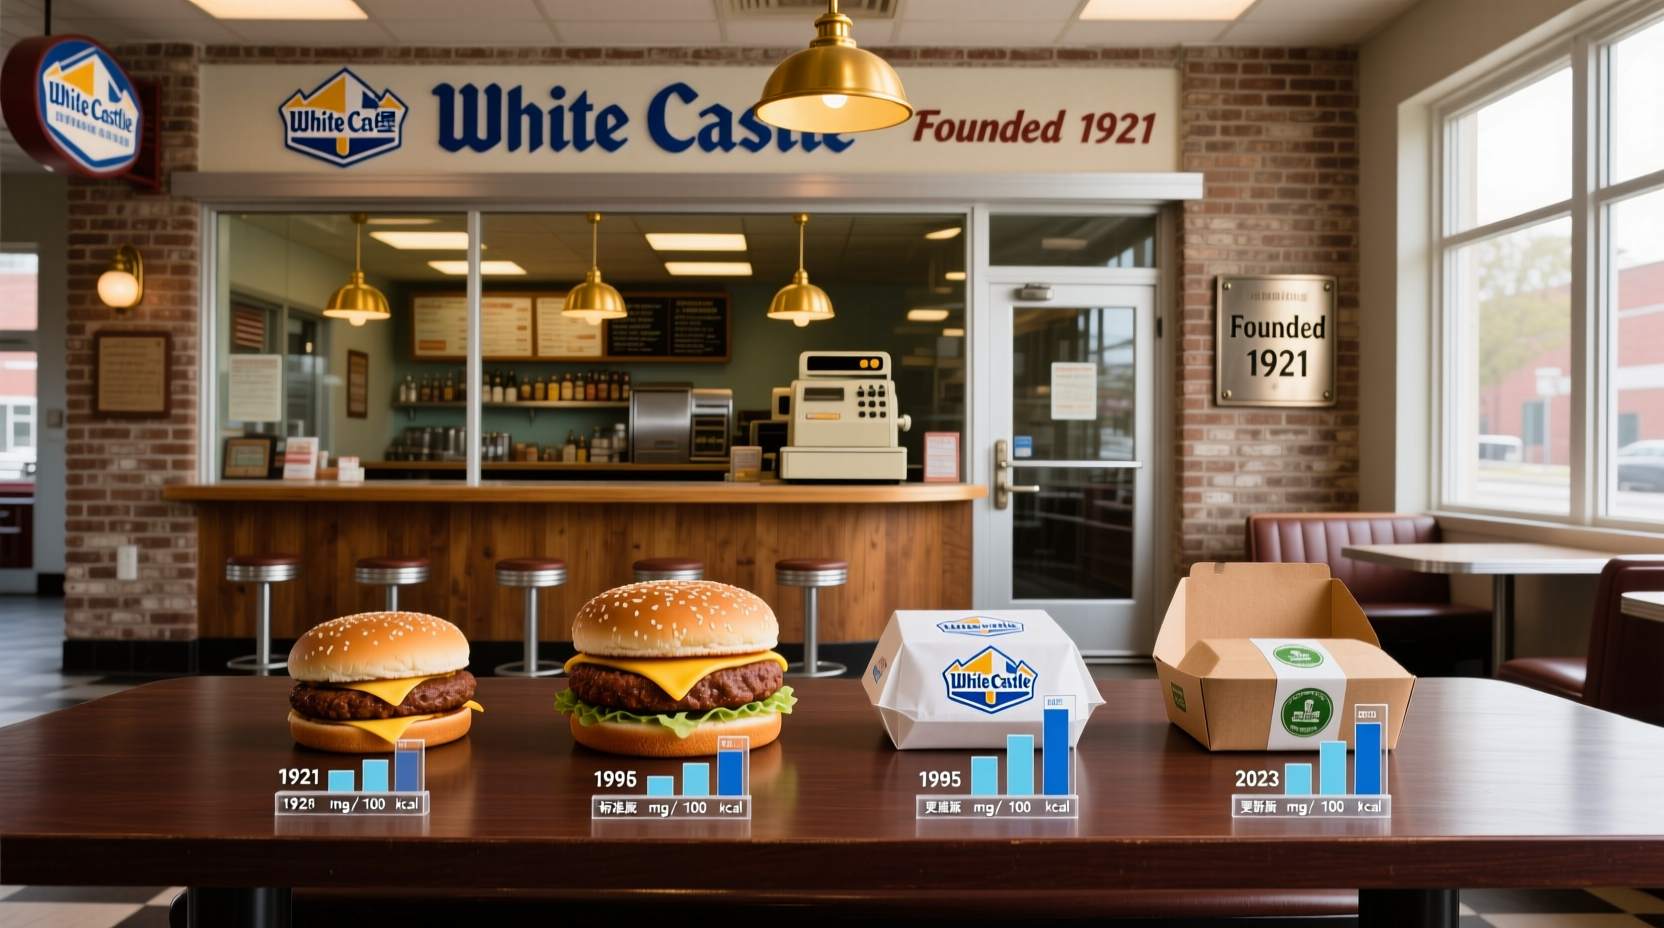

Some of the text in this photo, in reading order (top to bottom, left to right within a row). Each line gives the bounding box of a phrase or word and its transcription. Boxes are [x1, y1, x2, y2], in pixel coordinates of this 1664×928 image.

[289, 110, 345, 132] White
[432, 82, 855, 153] White Cas
[912, 109, 1156, 144] Founded 1921
[1230, 314, 1326, 339] Founded
[1246, 349, 1307, 377] 1921
[991, 673, 1031, 689] Castle
